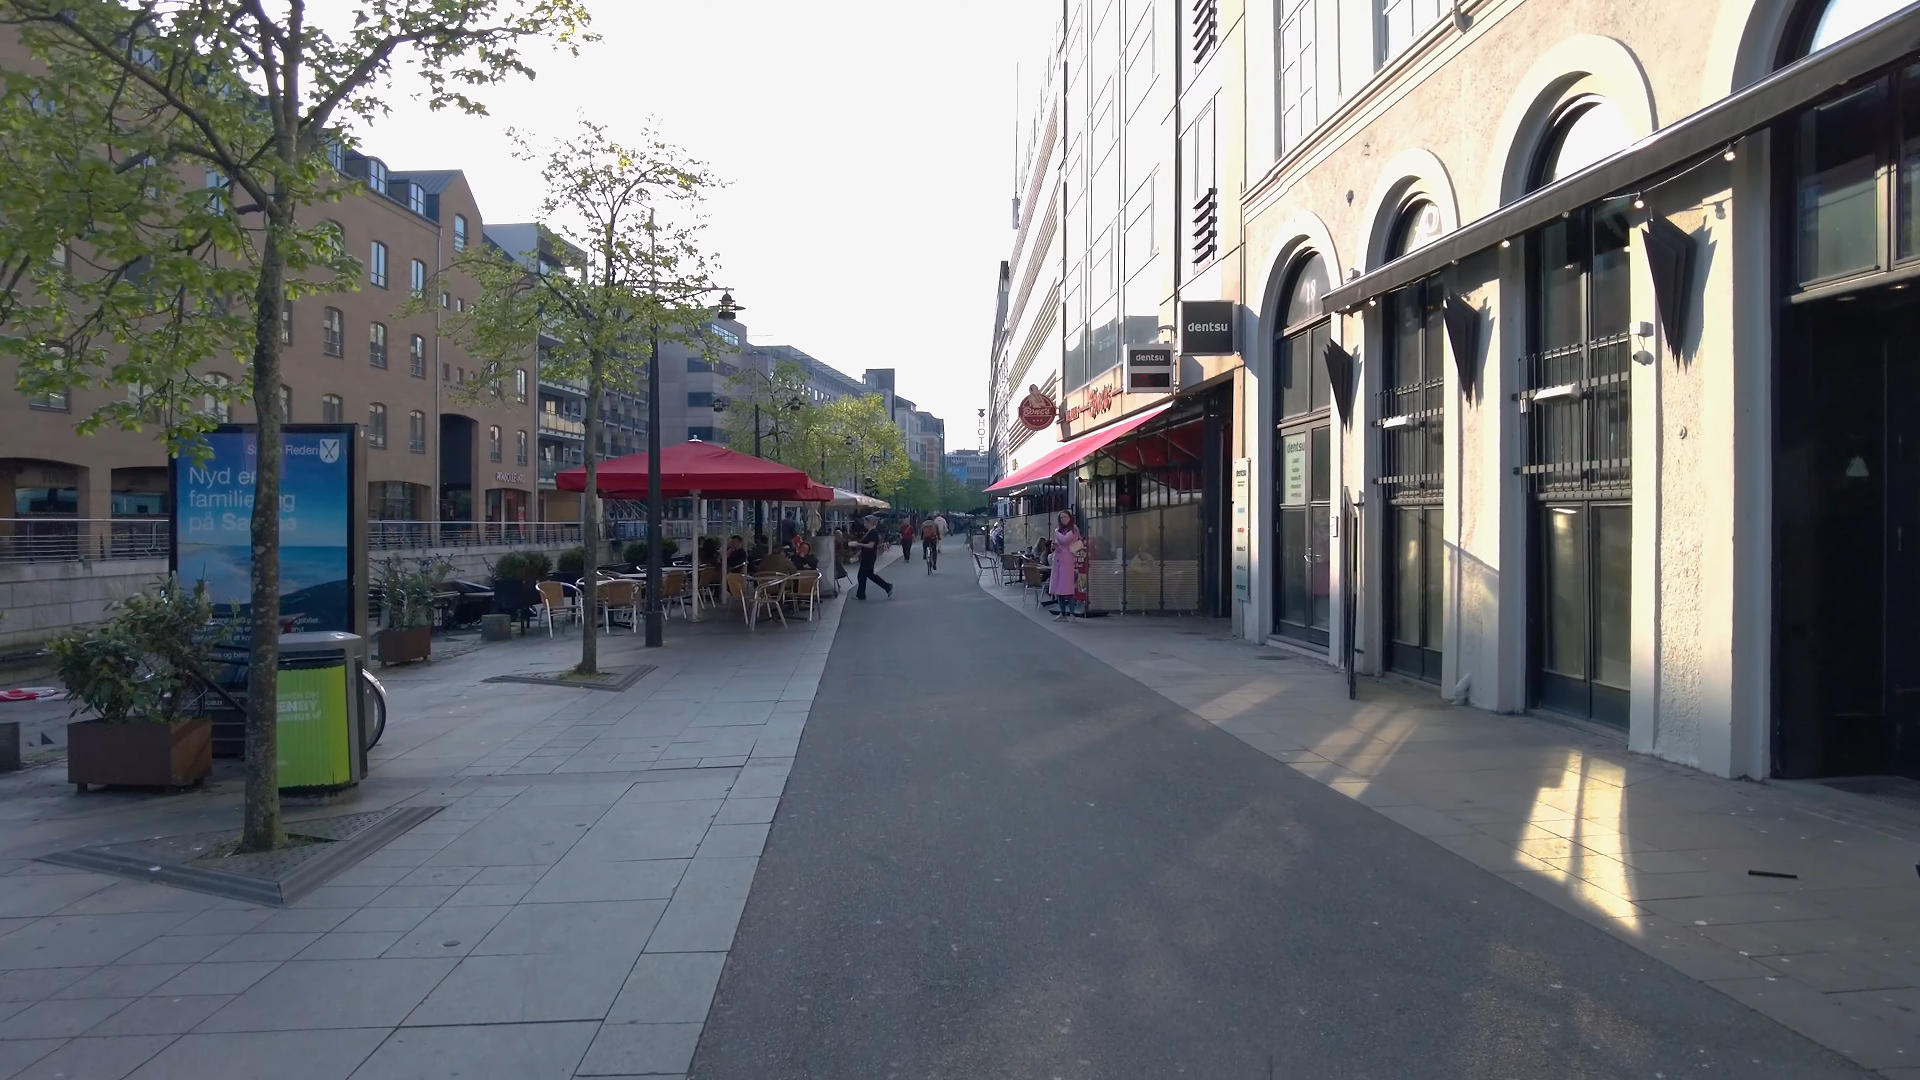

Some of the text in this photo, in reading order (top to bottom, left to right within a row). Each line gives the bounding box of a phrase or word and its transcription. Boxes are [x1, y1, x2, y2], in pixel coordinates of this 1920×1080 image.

[1306, 280, 1316, 303] 18
[1187, 322, 1228, 332] dentsu
[1023, 406, 1051, 416] Bone's
[285, 445, 319, 455] Rederi
[189, 467, 231, 488] Nyd
[189, 511, 215, 534] på
[276, 700, 318, 713] ENBY
